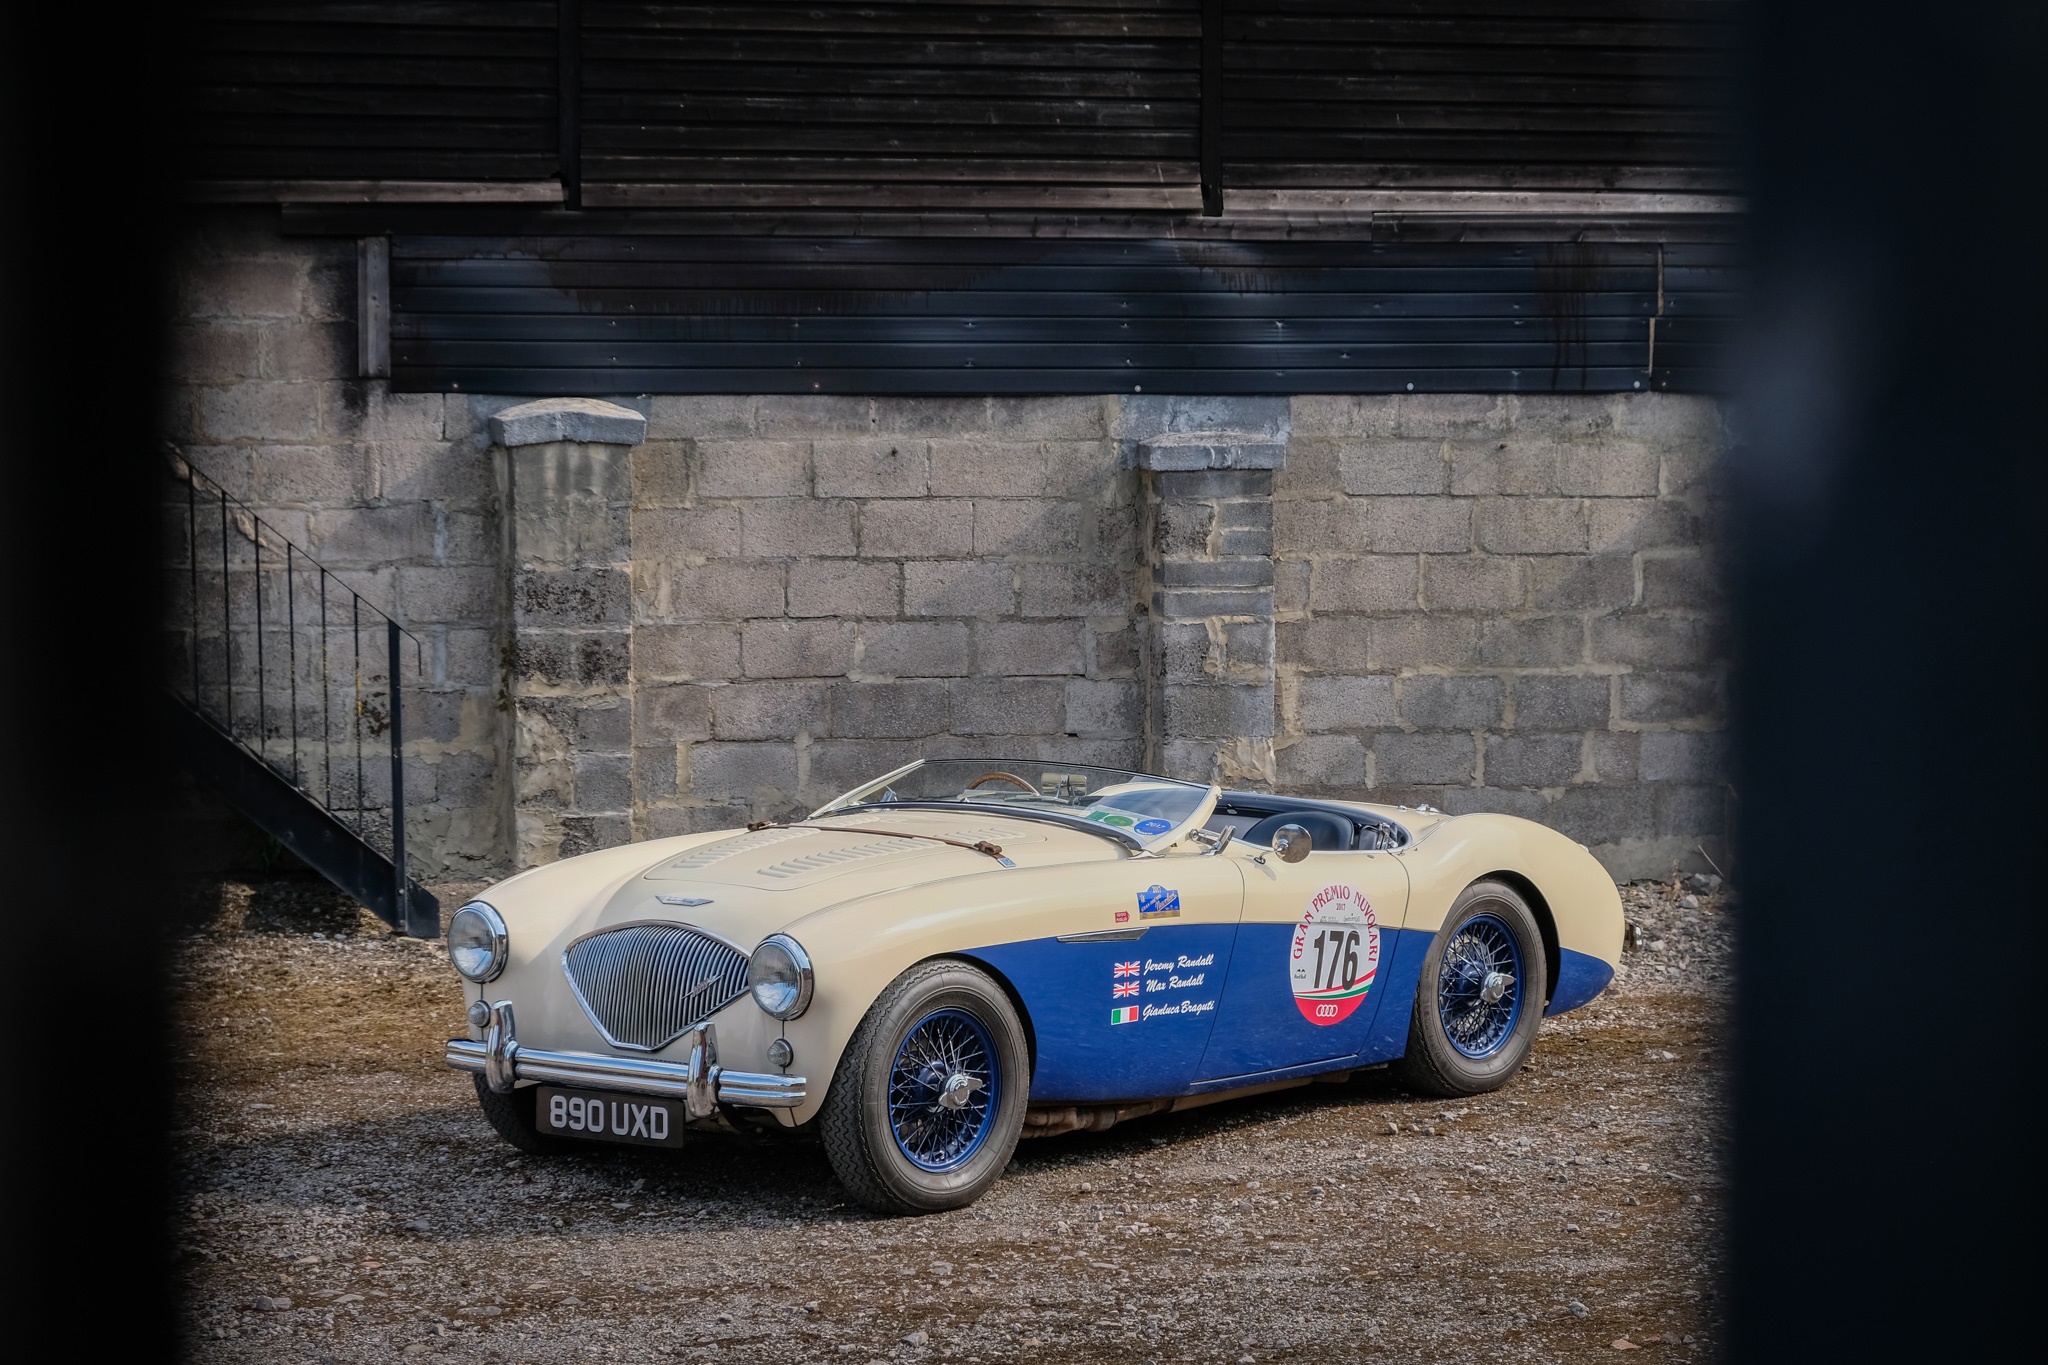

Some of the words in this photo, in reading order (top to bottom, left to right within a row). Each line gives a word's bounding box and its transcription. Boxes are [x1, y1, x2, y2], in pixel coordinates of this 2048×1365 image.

[1293, 911, 1314, 959] GRAN
[1312, 885, 1350, 913] PREMIO
[1354, 891, 1378, 962] NUVOLARI
[1144, 959, 1173, 975] Jeremy
[1178, 954, 1213, 969] Randall
[1314, 930, 1360, 990] 176
[1146, 979, 1167, 992] Max
[1168, 974, 1204, 988] Randall
[1142, 1003, 1180, 1021] Gianluca
[1181, 1000, 1215, 1015] Braguti
[549, 1095, 605, 1133] 890
[611, 1101, 669, 1140] UXD
